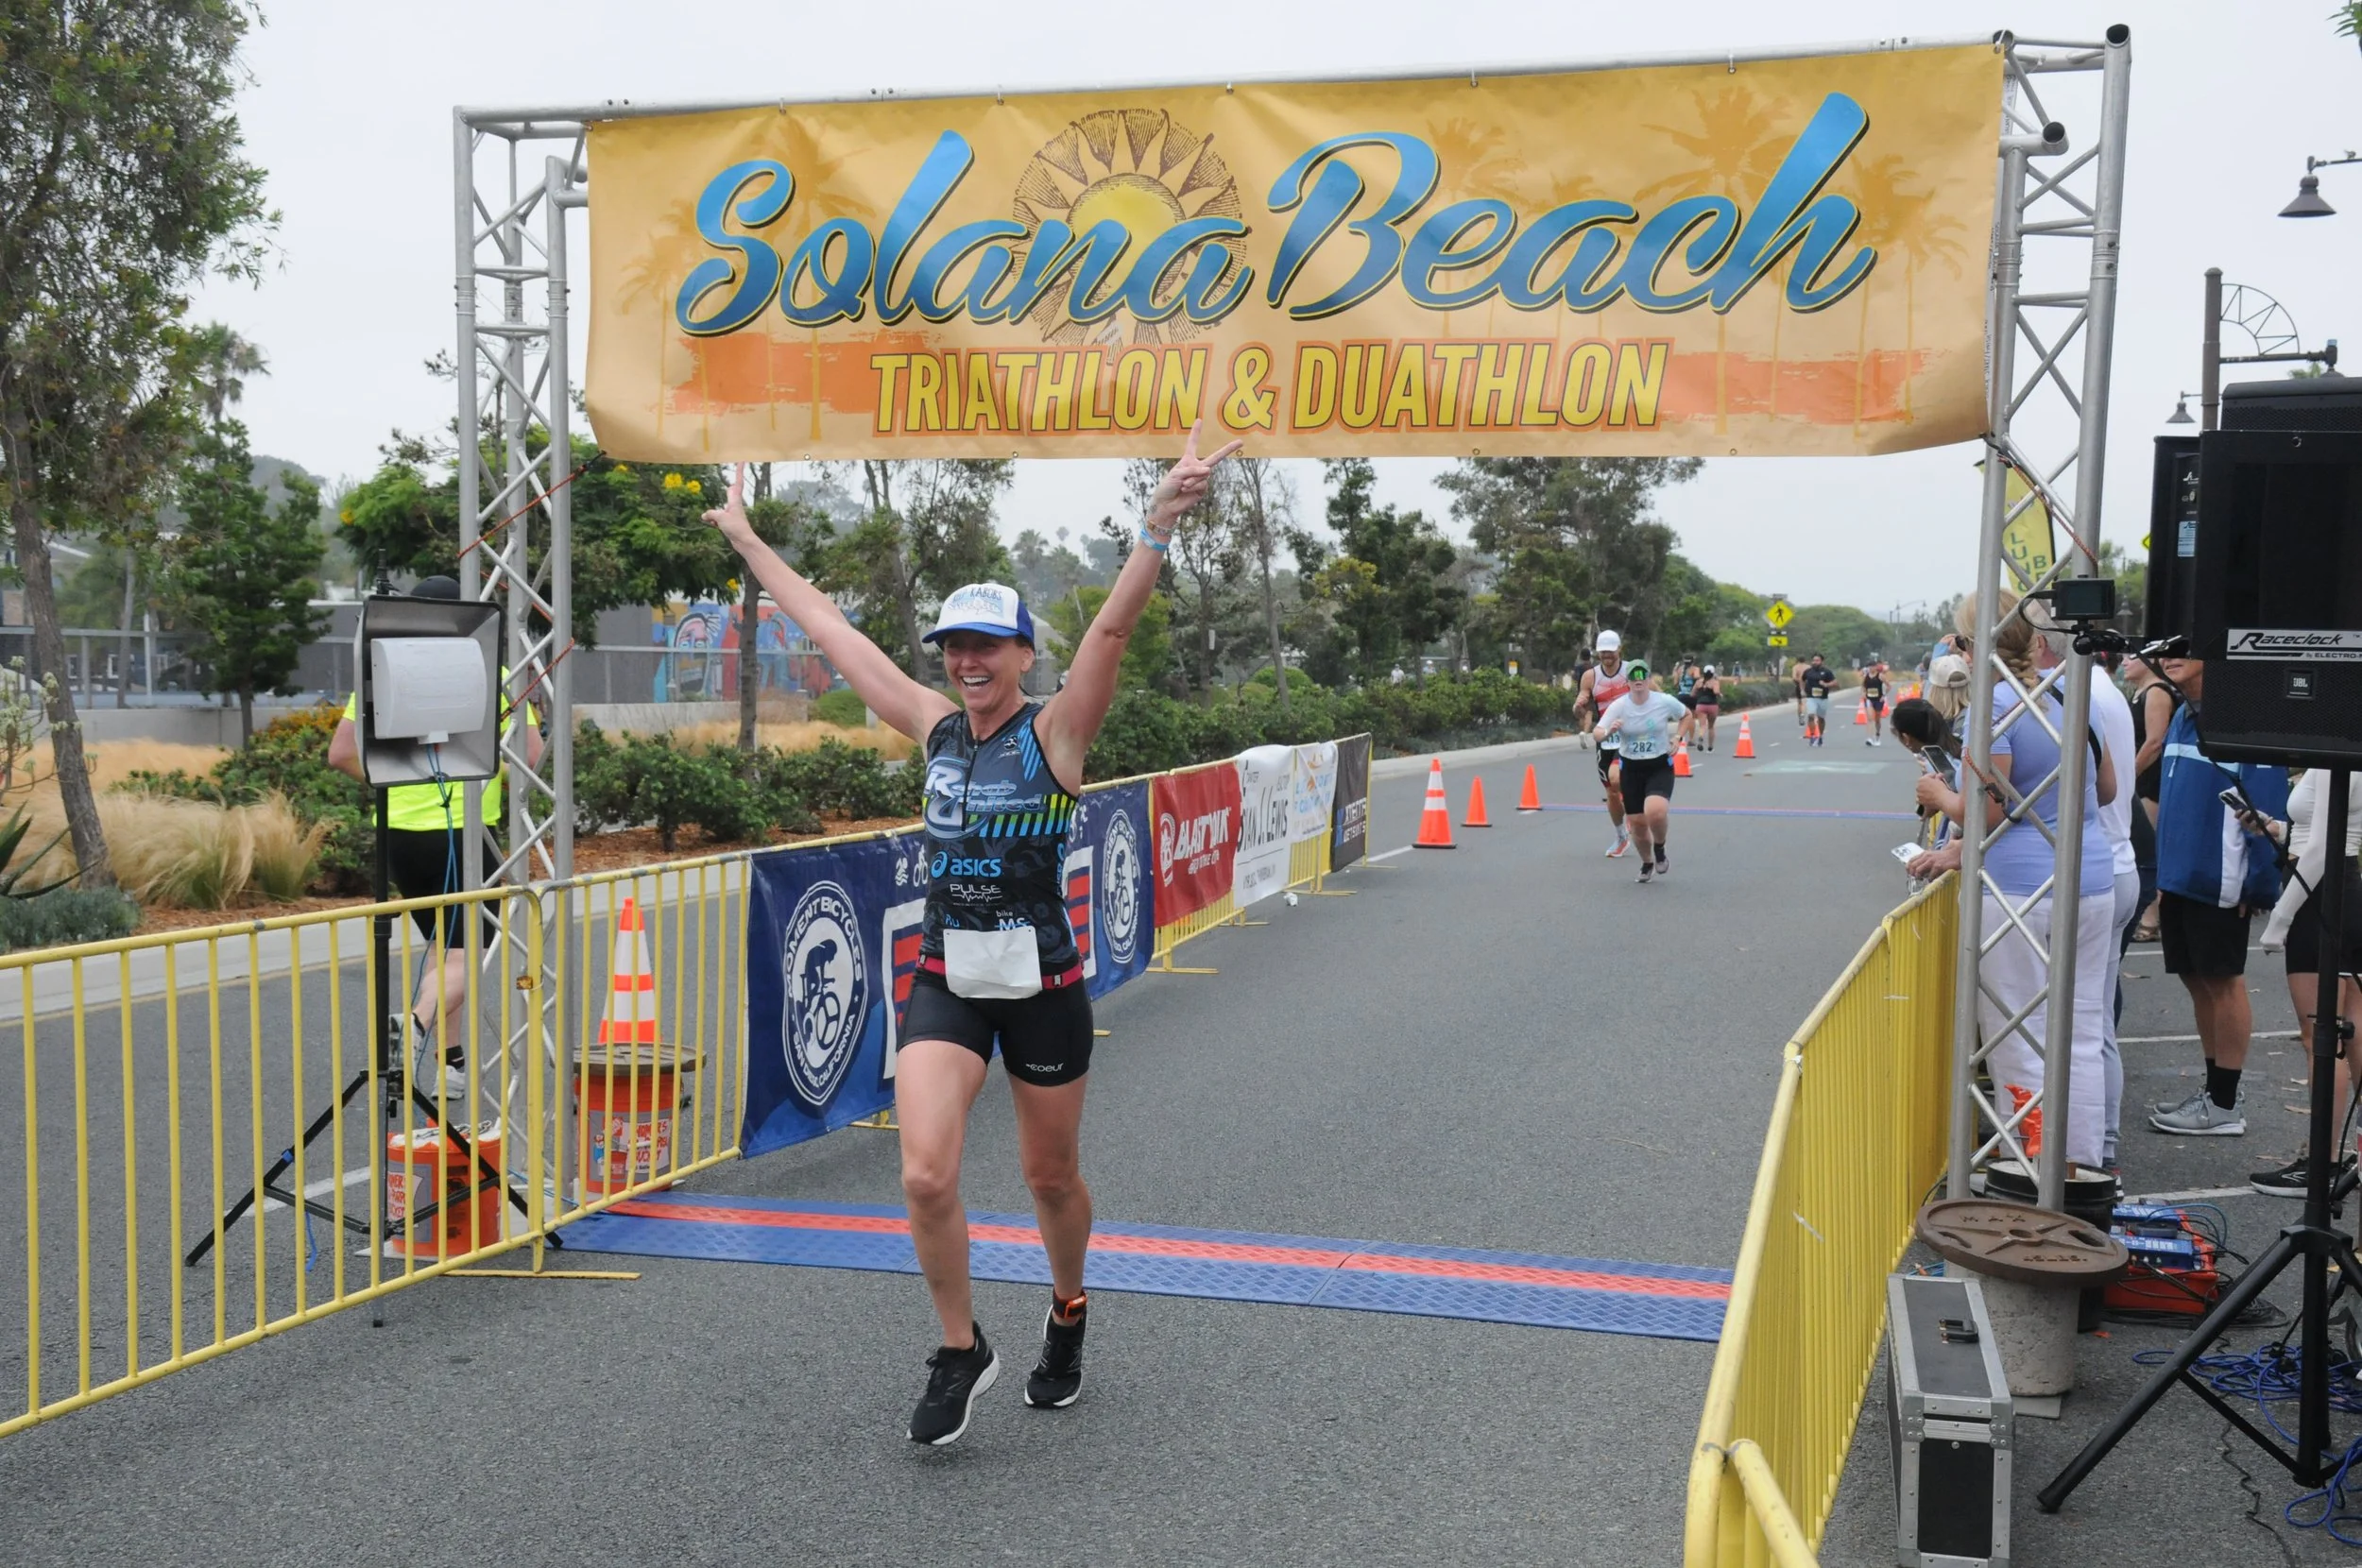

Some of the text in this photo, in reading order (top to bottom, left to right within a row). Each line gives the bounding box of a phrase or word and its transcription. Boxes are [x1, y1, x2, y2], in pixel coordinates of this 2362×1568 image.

[675, 91, 1878, 337] Solana Beach
[870, 342, 1669, 434] TRIATHLON & DUATHLON
[2230, 632, 2343, 650] Raceclock
[2293, 677, 2308, 688] JBL
[1632, 741, 1652, 753] 282
[950, 883, 1002, 895] PULSE
[786, 897, 821, 997] MOMENT
[819, 1014, 855, 1086] CALIFORNIA
[1026, 1063, 1064, 1072] coeur
